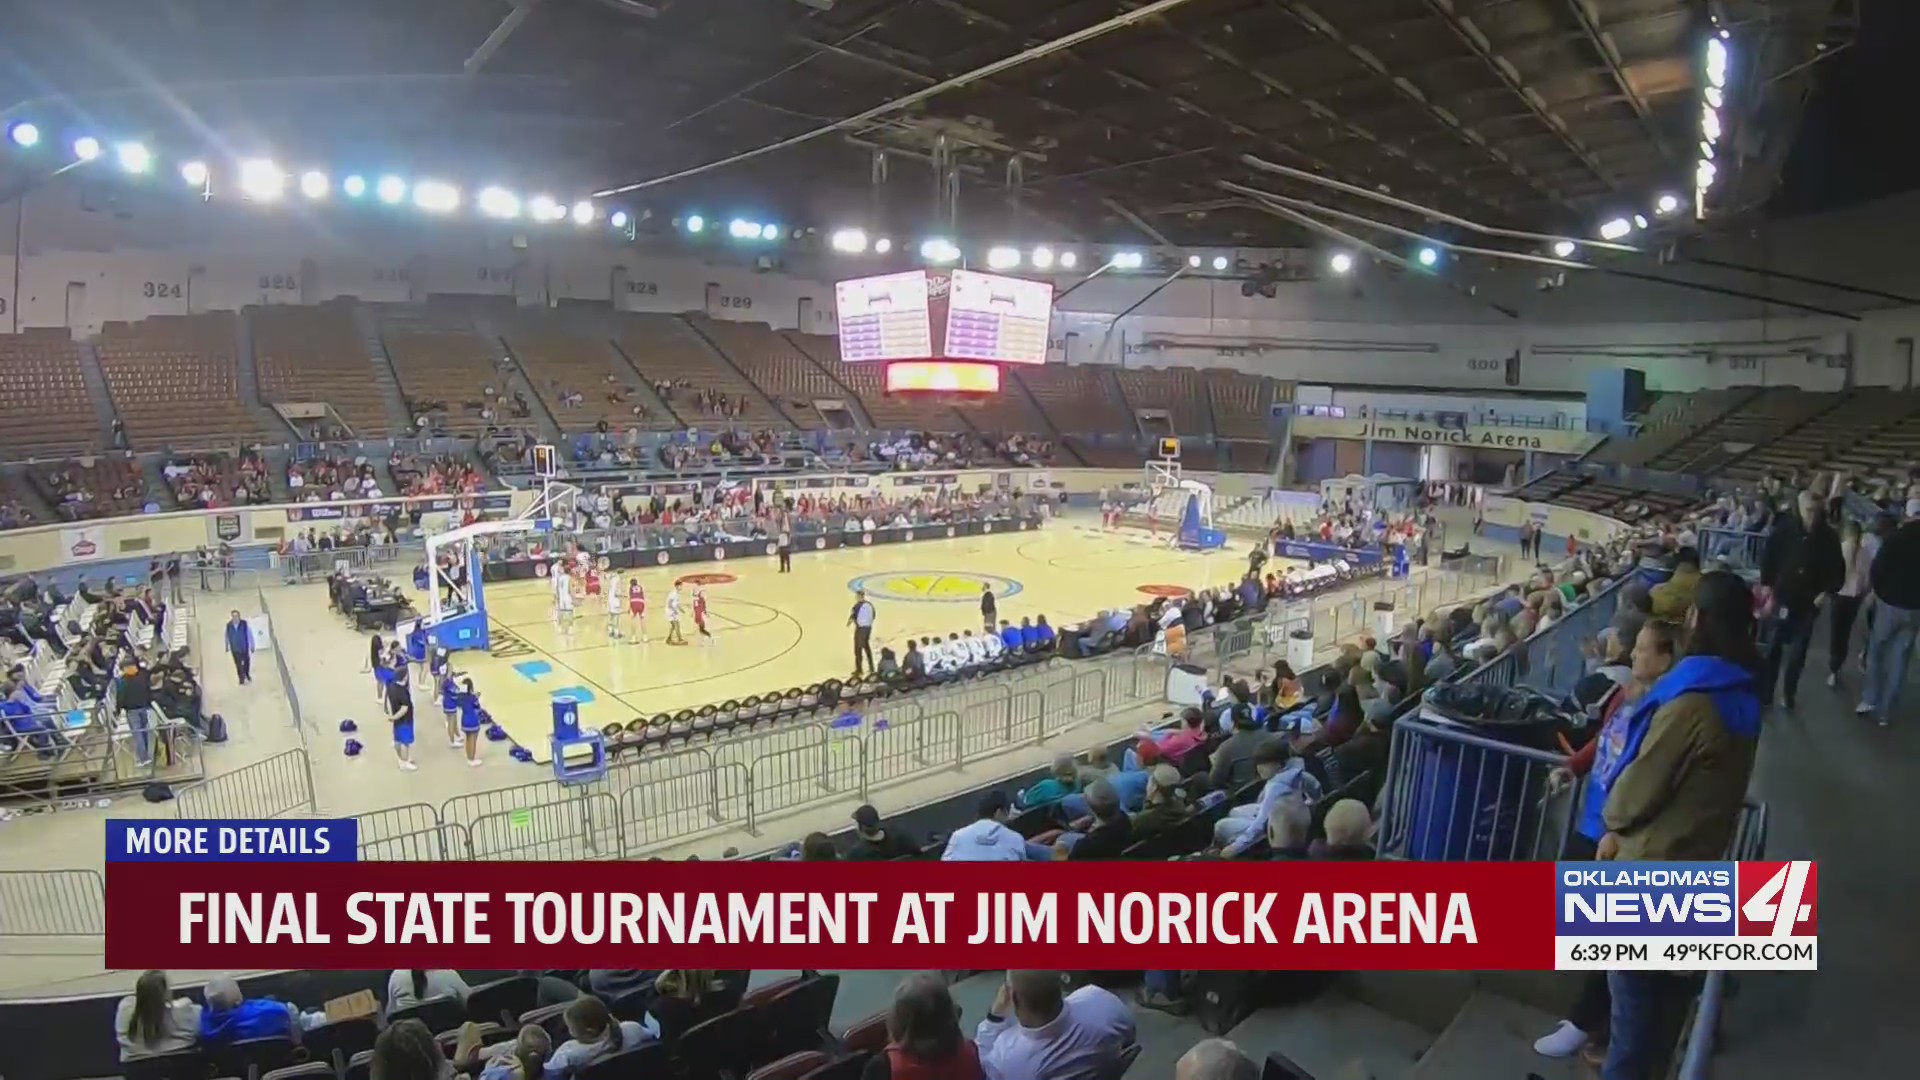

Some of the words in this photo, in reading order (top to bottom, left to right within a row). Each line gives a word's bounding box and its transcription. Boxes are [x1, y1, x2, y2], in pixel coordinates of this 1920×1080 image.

[144, 281, 183, 299] 324
[721, 296, 752, 309] 329
[1357, 422, 1396, 437] Jim
[1405, 426, 1473, 443] Norick
[1481, 431, 1542, 449] Arena
